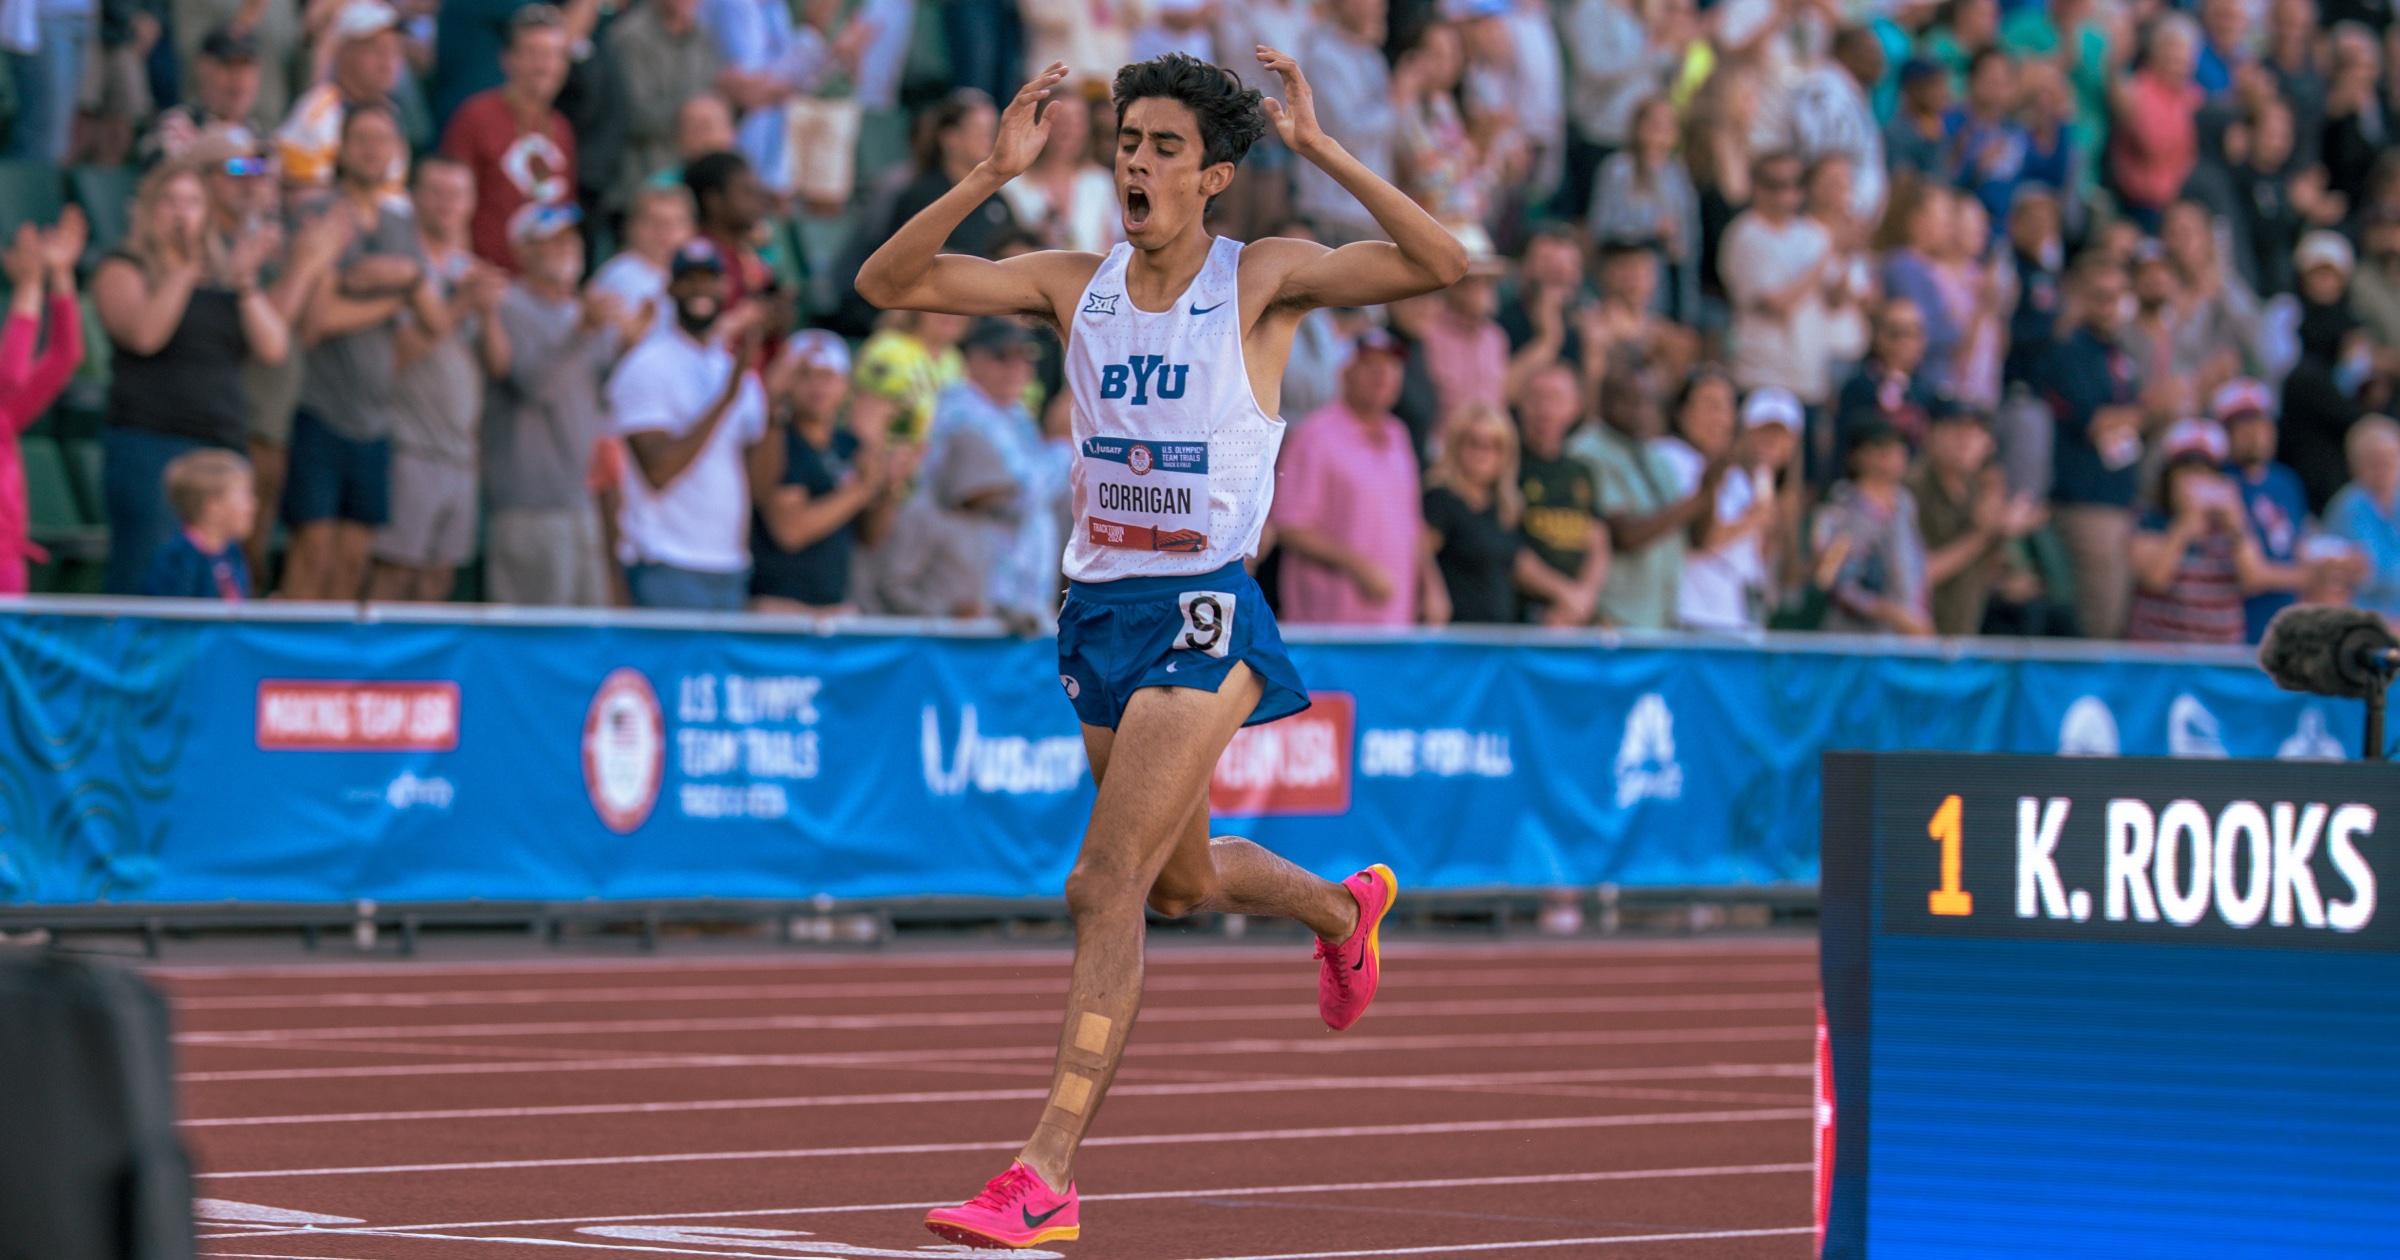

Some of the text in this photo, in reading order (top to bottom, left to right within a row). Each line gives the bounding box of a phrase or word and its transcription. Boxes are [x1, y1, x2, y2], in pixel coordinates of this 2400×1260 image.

[1100, 355, 1189, 405] BYU
[1161, 446, 1174, 454] U.S.
[1162, 454, 1201, 462] TEAM TRIALS
[1099, 482, 1191, 515] CORRIGAN
[1185, 596, 1223, 651] 9
[1928, 795, 2378, 932] 1 K. ROOKS
